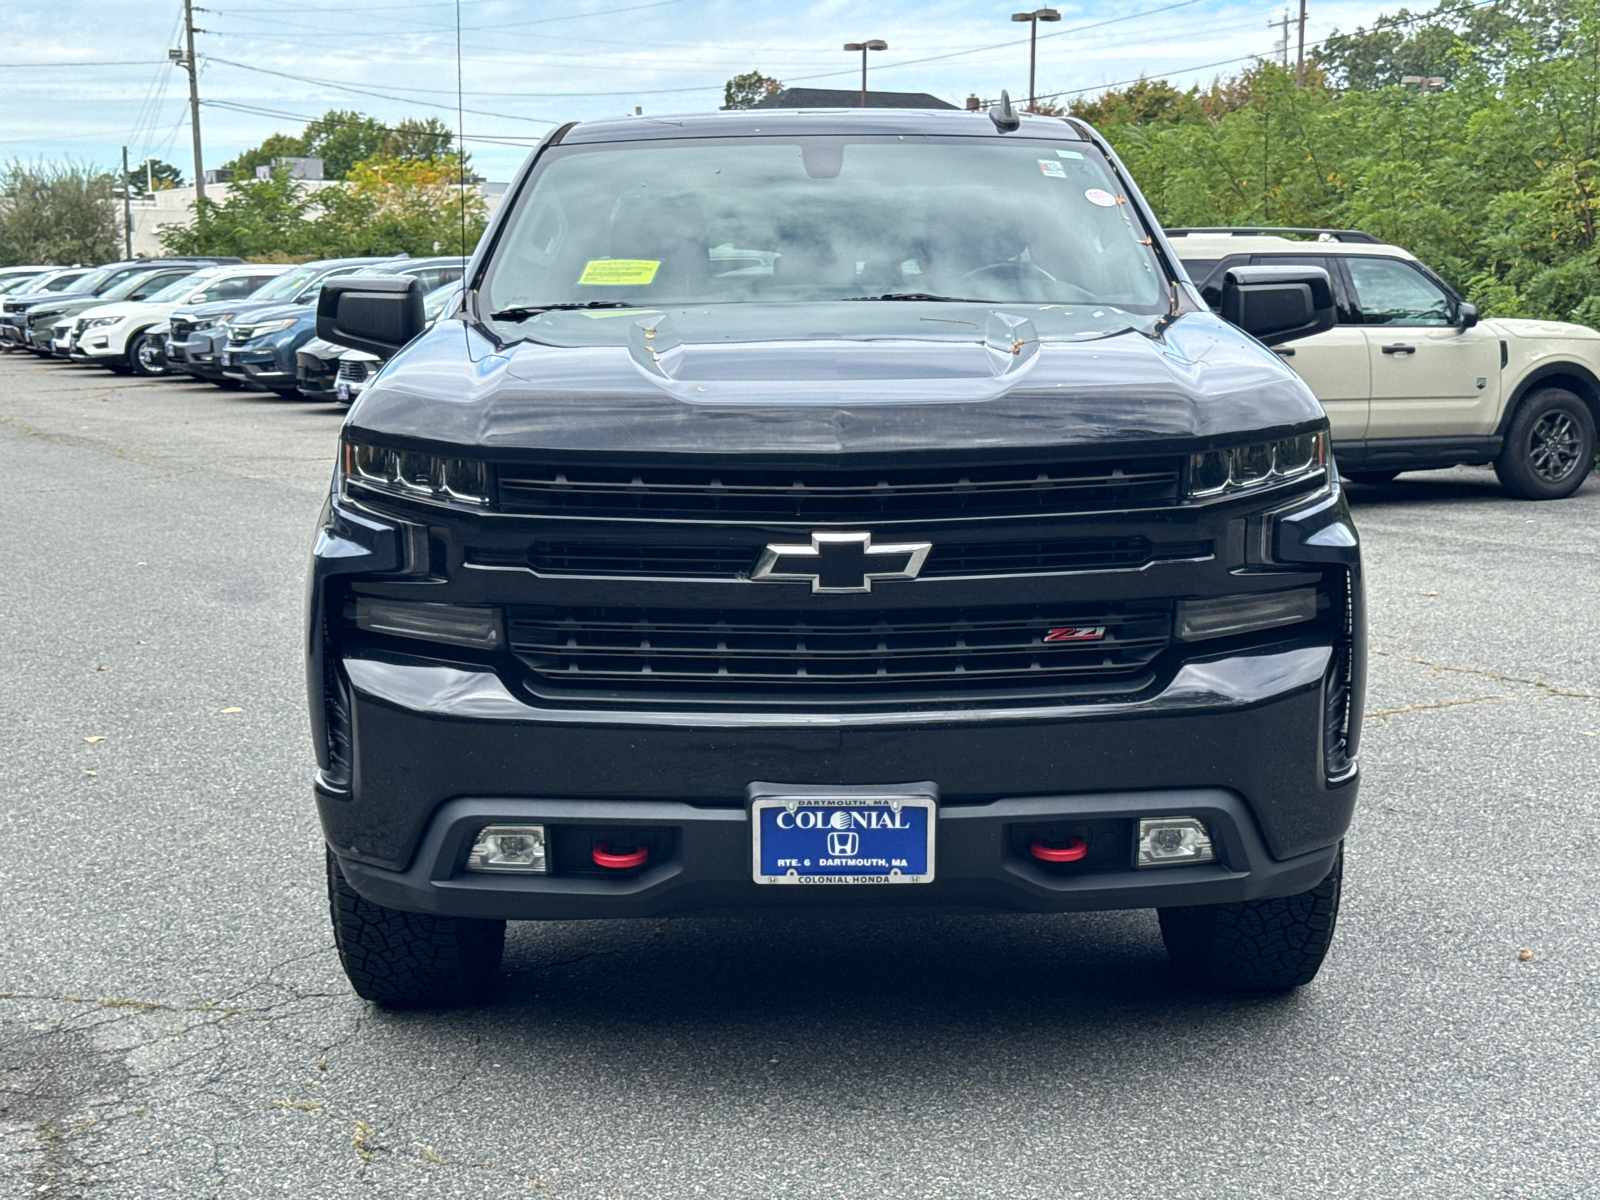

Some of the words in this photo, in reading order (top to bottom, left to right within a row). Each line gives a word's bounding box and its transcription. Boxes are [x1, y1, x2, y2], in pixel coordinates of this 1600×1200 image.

[1043, 626, 1107, 642] Z71
[776, 811, 910, 829] COLONIAL
[777, 859, 801, 867] RTE.
[803, 859, 811, 867] 6
[819, 859, 889, 868] DARTMOUTH,
[891, 859, 908, 867] MA
